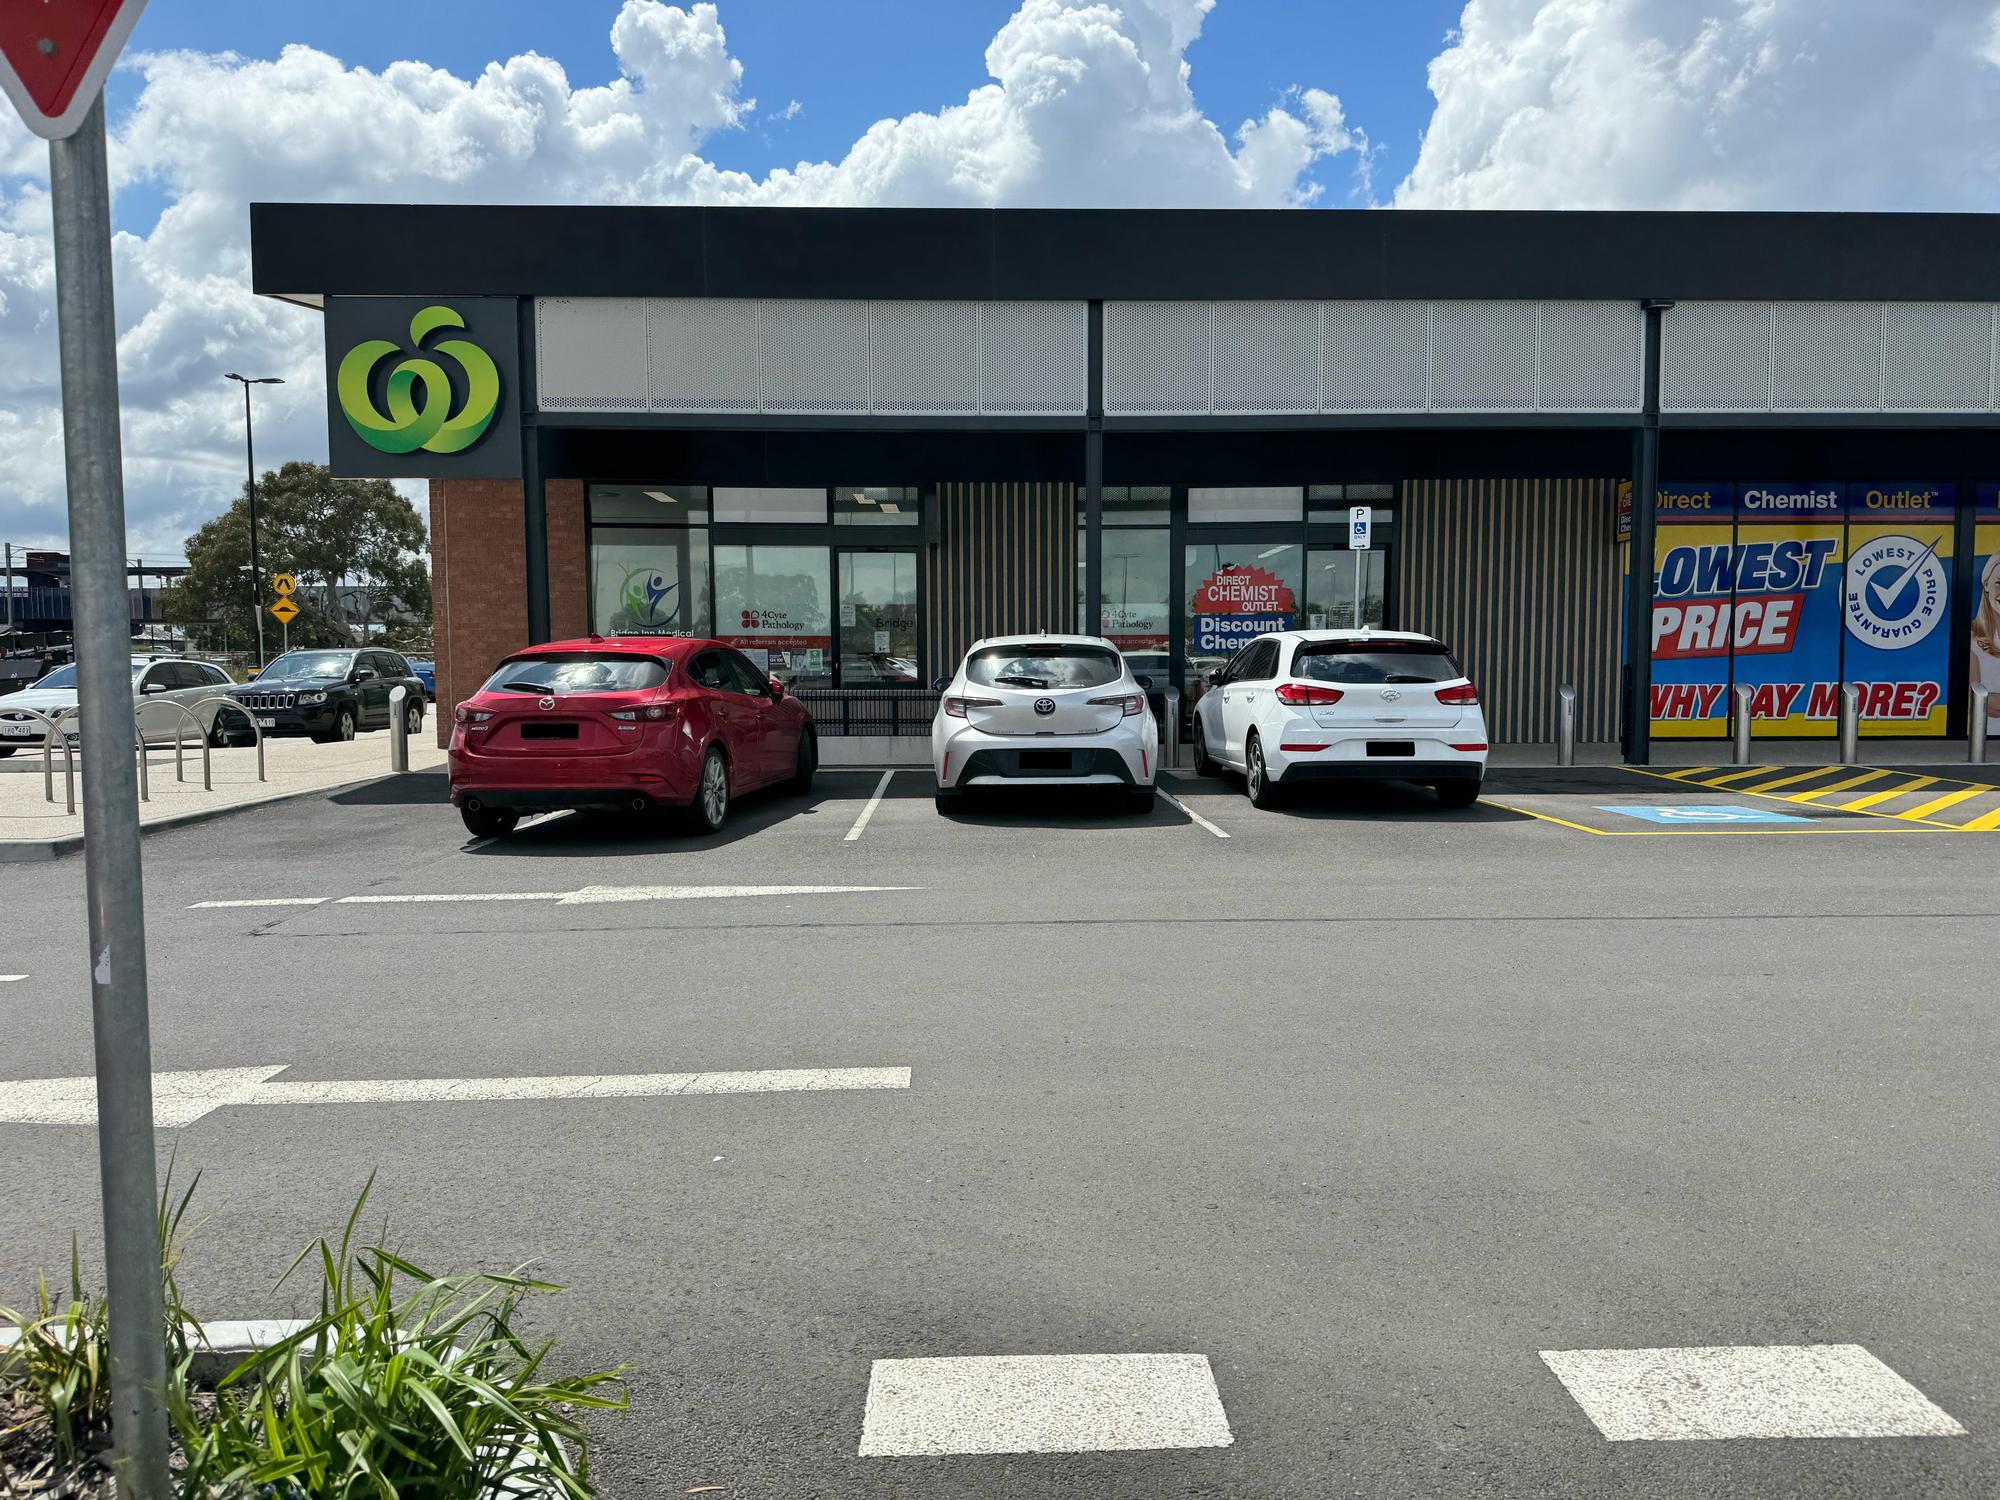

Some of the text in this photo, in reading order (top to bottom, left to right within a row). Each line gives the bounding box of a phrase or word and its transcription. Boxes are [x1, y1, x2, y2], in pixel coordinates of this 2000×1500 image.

[1744, 489, 1837, 510] Chemist
[1356, 508, 1365, 519] P
[1652, 538, 1839, 598] OWEST
[1216, 575, 1251, 585] DIRECT
[1207, 585, 1278, 601] CHEMIST
[1848, 548, 1937, 638] LOWEST PRICE GUARANTEE
[761, 610, 787, 620] 4Cyte
[1112, 610, 1137, 620] 4Cyte
[762, 620, 805, 631] Pathology
[875, 617, 913, 631] Bridge
[1112, 619, 1153, 630] Pathology
[1200, 617, 1285, 632] Discount
[1652, 600, 1793, 652] PRICE
[658, 629, 694, 637] Medical
[1733, 684, 1804, 720] AY
